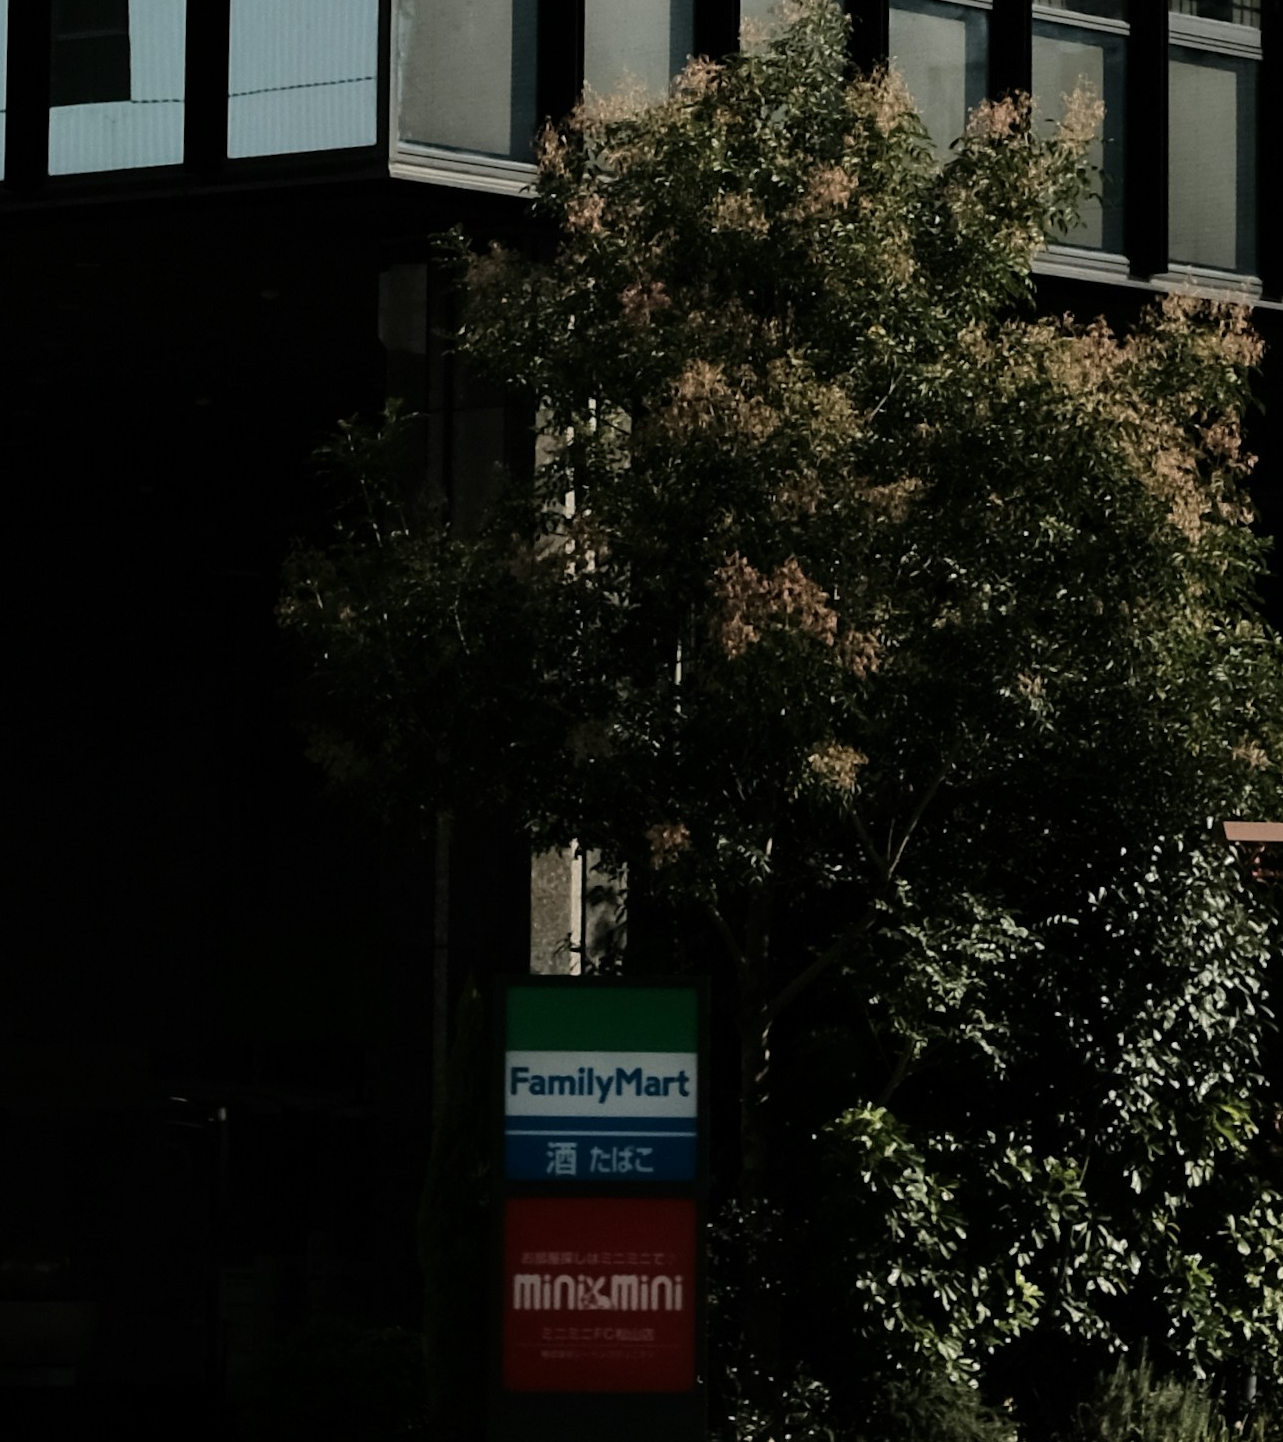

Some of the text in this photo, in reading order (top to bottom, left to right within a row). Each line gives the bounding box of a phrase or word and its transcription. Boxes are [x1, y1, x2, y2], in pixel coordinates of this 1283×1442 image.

[510, 1066, 690, 1104] FamilyMart
[545, 1140, 655, 1177] 酒 たばこ
